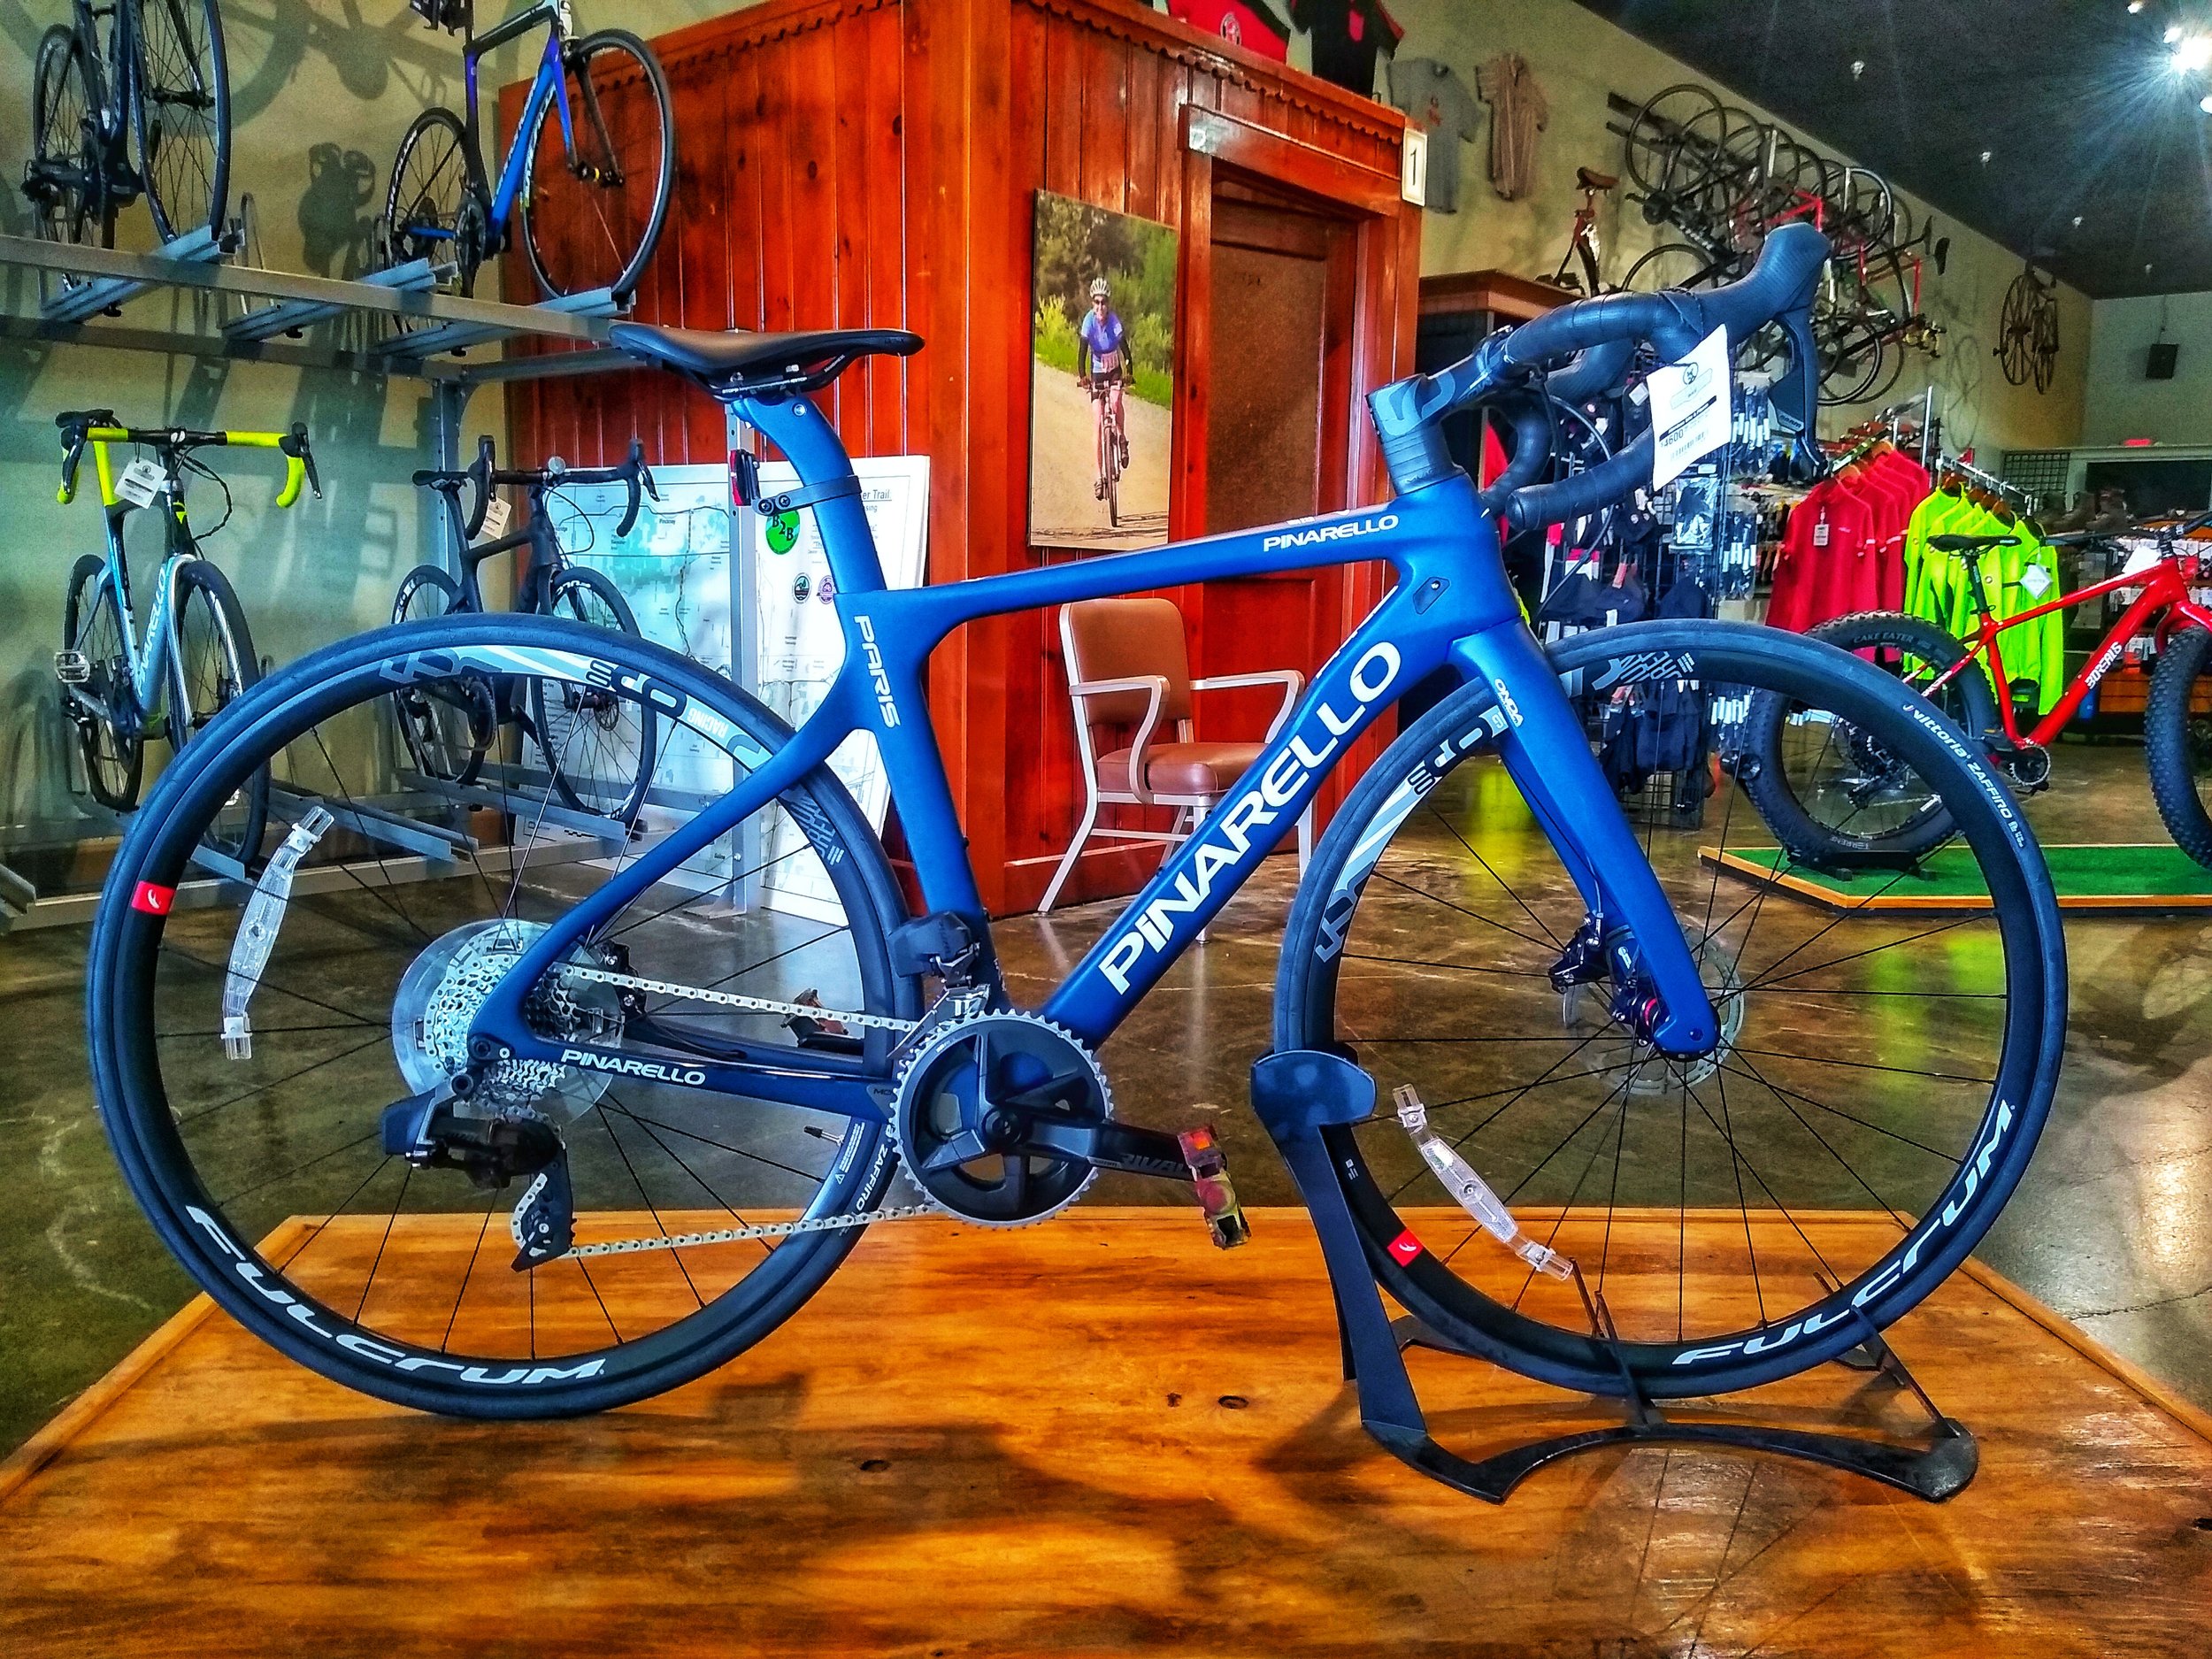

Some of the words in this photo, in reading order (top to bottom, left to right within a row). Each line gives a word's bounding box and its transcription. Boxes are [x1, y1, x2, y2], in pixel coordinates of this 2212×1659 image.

[1409, 148, 1417, 186] 1
[872, 488, 891, 500] Trail
[1263, 514, 1400, 552] PINARELLO
[1854, 633, 1881, 643] CAKE
[1883, 631, 1914, 642] EATER
[855, 615, 902, 729] PARIS
[687, 707, 729, 738] RACING
[1494, 679, 1525, 727] ONDA
[1913, 710, 1969, 759] vittoria
[1967, 762, 2013, 818] ZAFFIRO
[1098, 641, 1402, 995] PINARELLO
[561, 1048, 706, 1086] PINARELLO
[854, 1143, 889, 1214] ZAFFIRO
[1671, 1099, 2014, 1365] FULCRUM
[184, 1204, 605, 1386] FULCRUM
